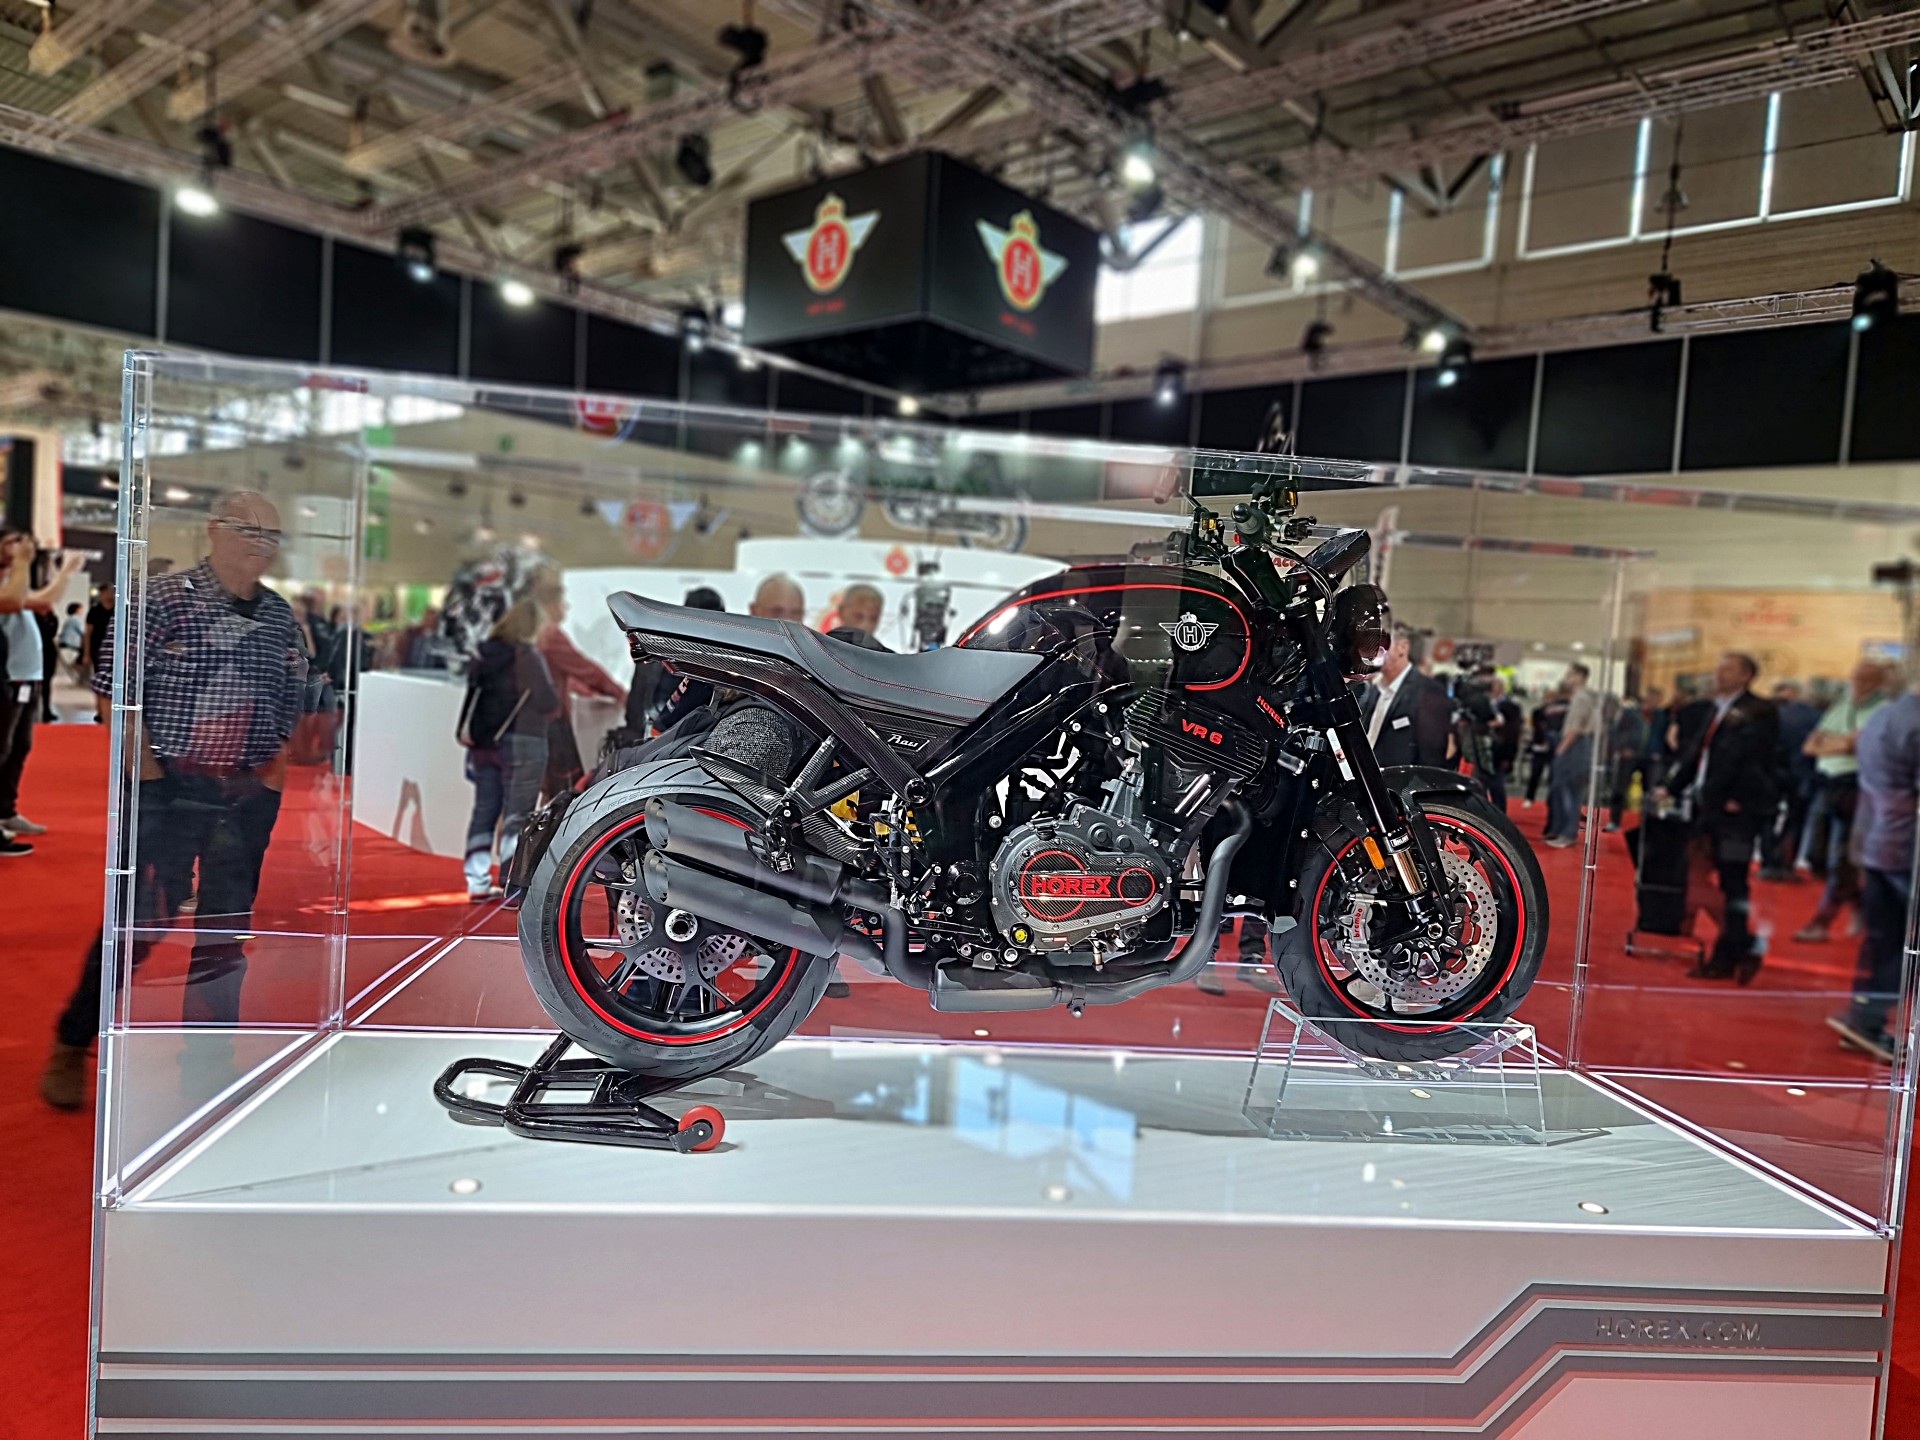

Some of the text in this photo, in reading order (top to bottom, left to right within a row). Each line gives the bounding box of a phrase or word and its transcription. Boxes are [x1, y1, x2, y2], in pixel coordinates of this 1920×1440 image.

[817, 229, 840, 273] H
[1012, 246, 1033, 291] H
[1182, 625, 1198, 644] H
[1256, 695, 1286, 729] HOREX
[887, 733, 919, 748] Raw
[1182, 718, 1223, 745] VR 6
[1031, 874, 1112, 897] HOREX
[1353, 907, 1363, 938] brembo
[1596, 1316, 1761, 1341] HOREX.COM
